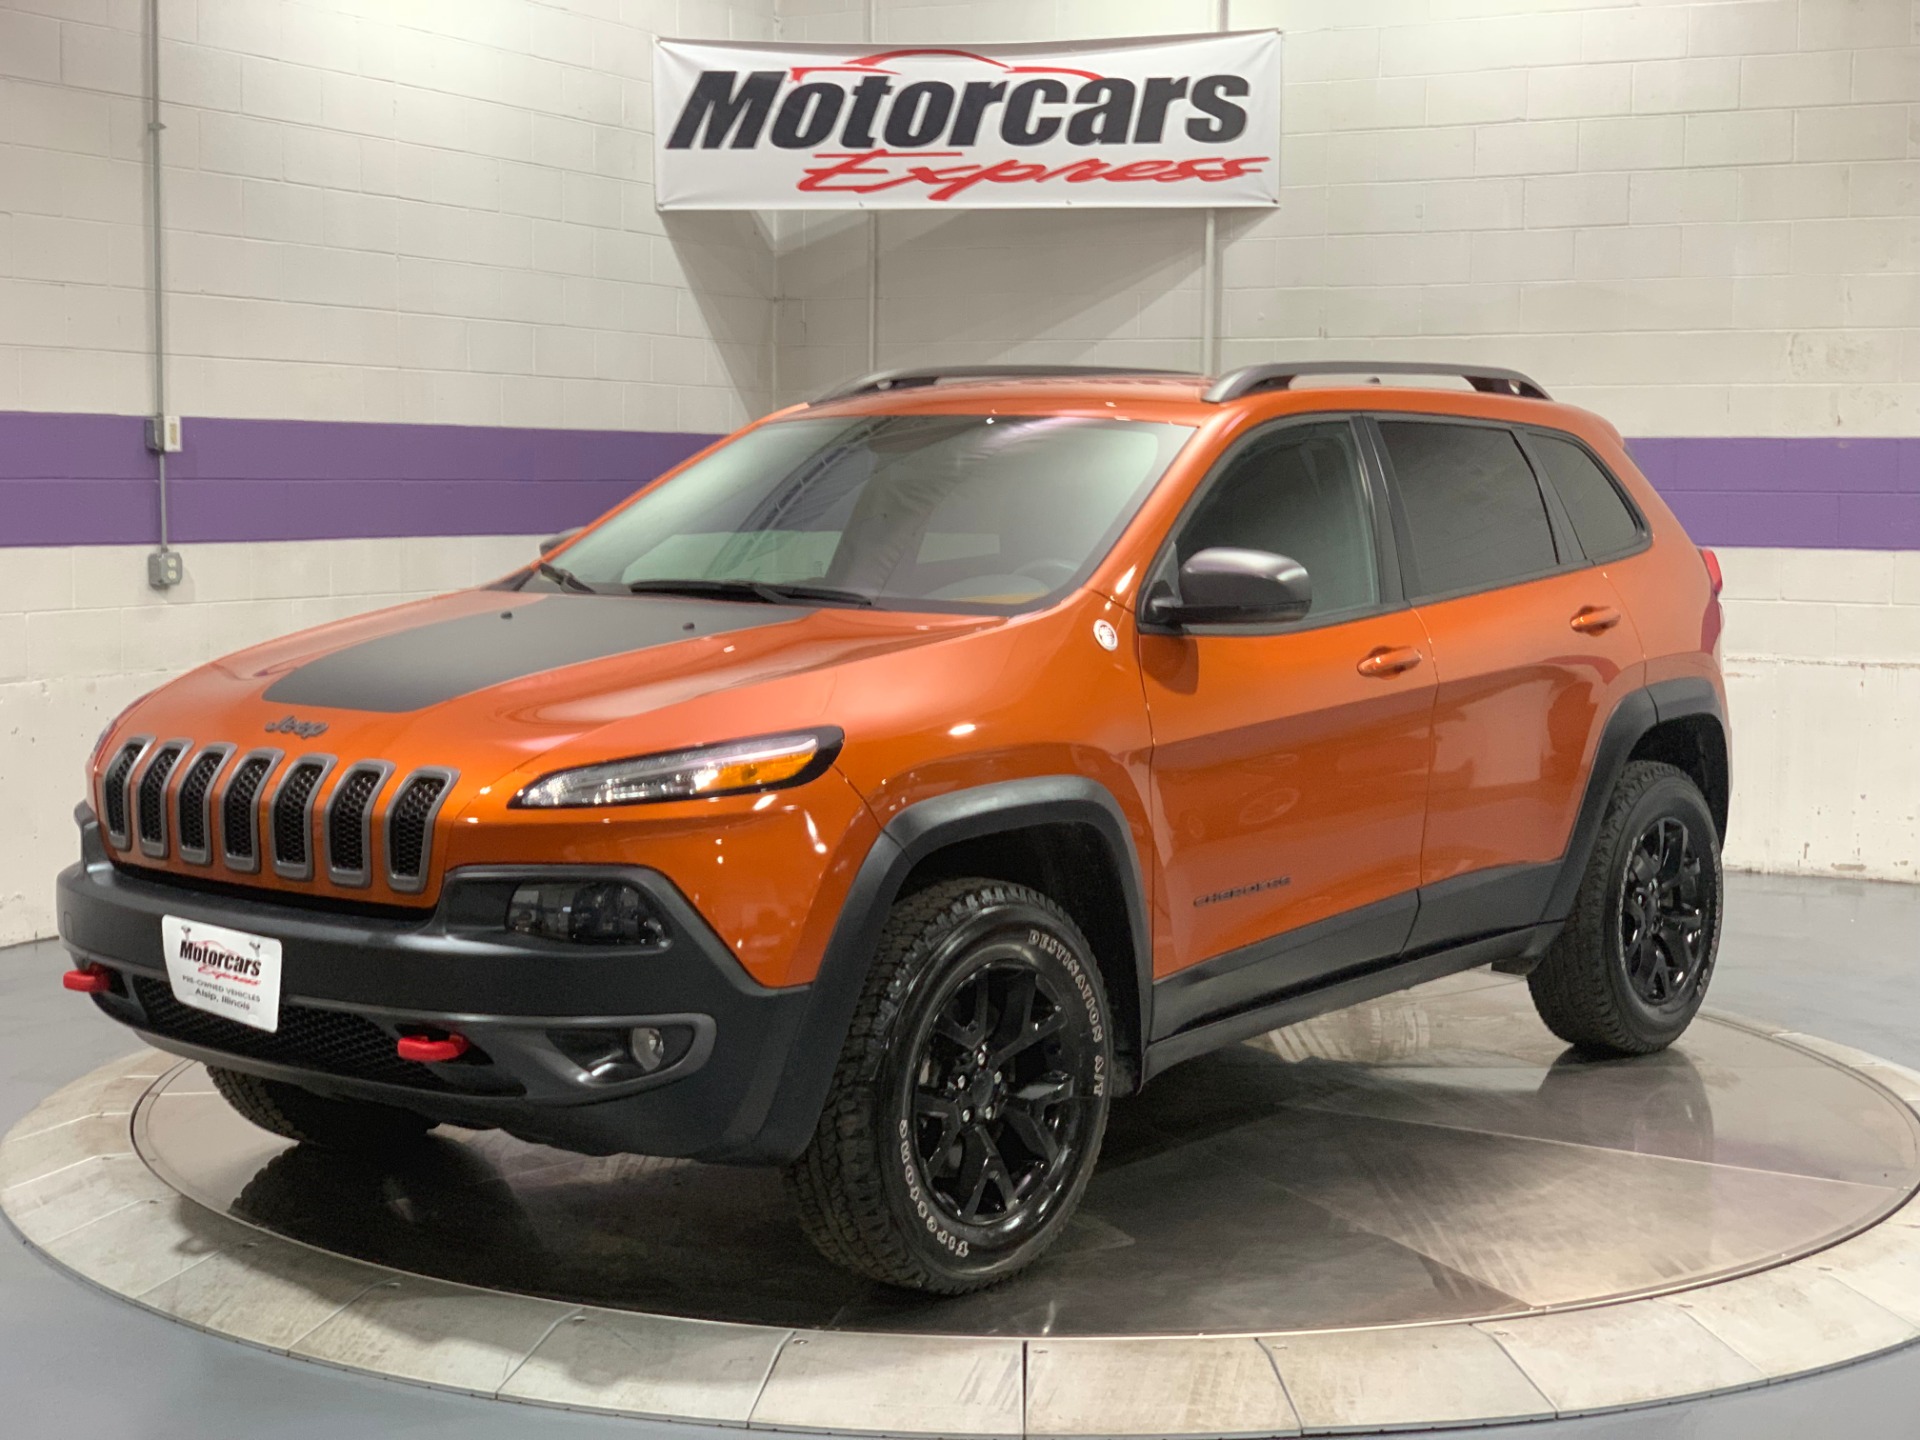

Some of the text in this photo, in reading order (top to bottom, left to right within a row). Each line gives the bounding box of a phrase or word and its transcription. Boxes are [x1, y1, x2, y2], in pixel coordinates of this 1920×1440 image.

[665, 70, 1251, 150] Motorcars
[796, 149, 1270, 201] Express
[264, 715, 329, 740] Jeep
[179, 940, 262, 977] Motorcars
[198, 964, 261, 987] Express
[195, 988, 251, 1011] Alsip, Illinois
[1028, 929, 1103, 1043] DESTINATION
